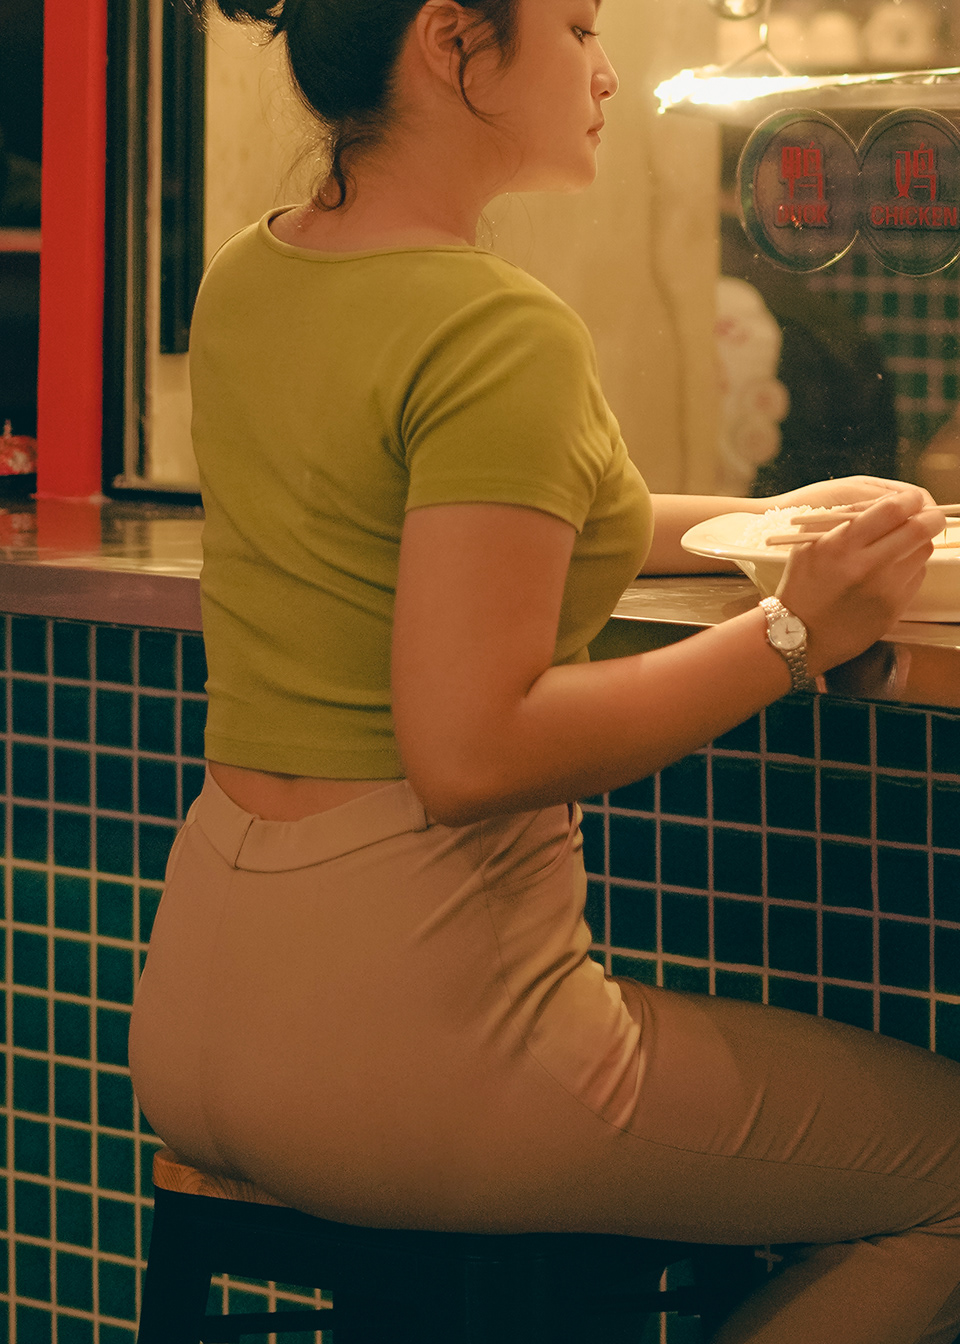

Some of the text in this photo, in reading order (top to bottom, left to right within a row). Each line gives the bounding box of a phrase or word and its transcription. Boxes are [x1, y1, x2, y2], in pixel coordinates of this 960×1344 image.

[781, 142, 824, 201] 鸭
[895, 143, 937, 201] 鸡
[777, 204, 829, 226] DUCK
[871, 205, 957, 228] CHICKEN
